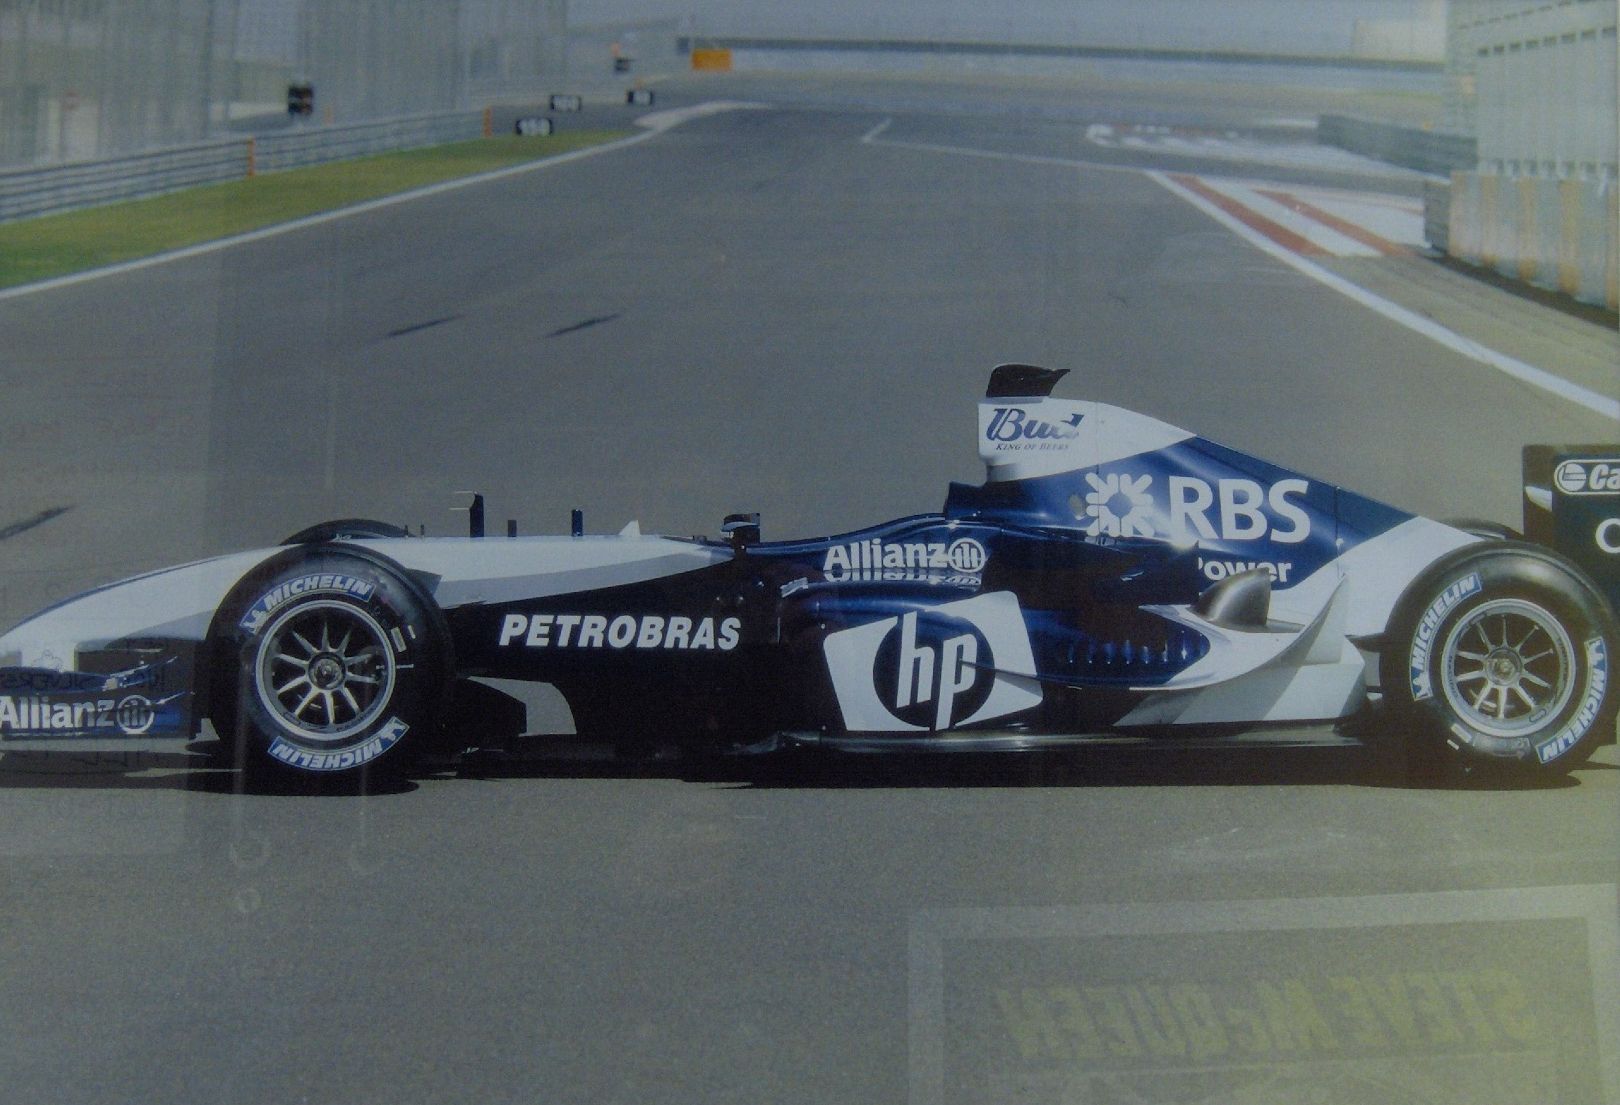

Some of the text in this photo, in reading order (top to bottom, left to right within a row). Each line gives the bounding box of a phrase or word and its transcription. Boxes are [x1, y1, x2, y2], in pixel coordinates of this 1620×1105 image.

[1169, 476, 1311, 545] RBS
[823, 538, 948, 571] Allianz
[263, 575, 373, 610] MICHELIN
[499, 614, 741, 650] PETROBRAS
[1411, 575, 1475, 672] MICHELIN
[896, 611, 978, 731] hp
[0, 696, 115, 729] Allianz
[1542, 668, 1606, 761] MICHELIN
[271, 738, 384, 769] MICHELIN
